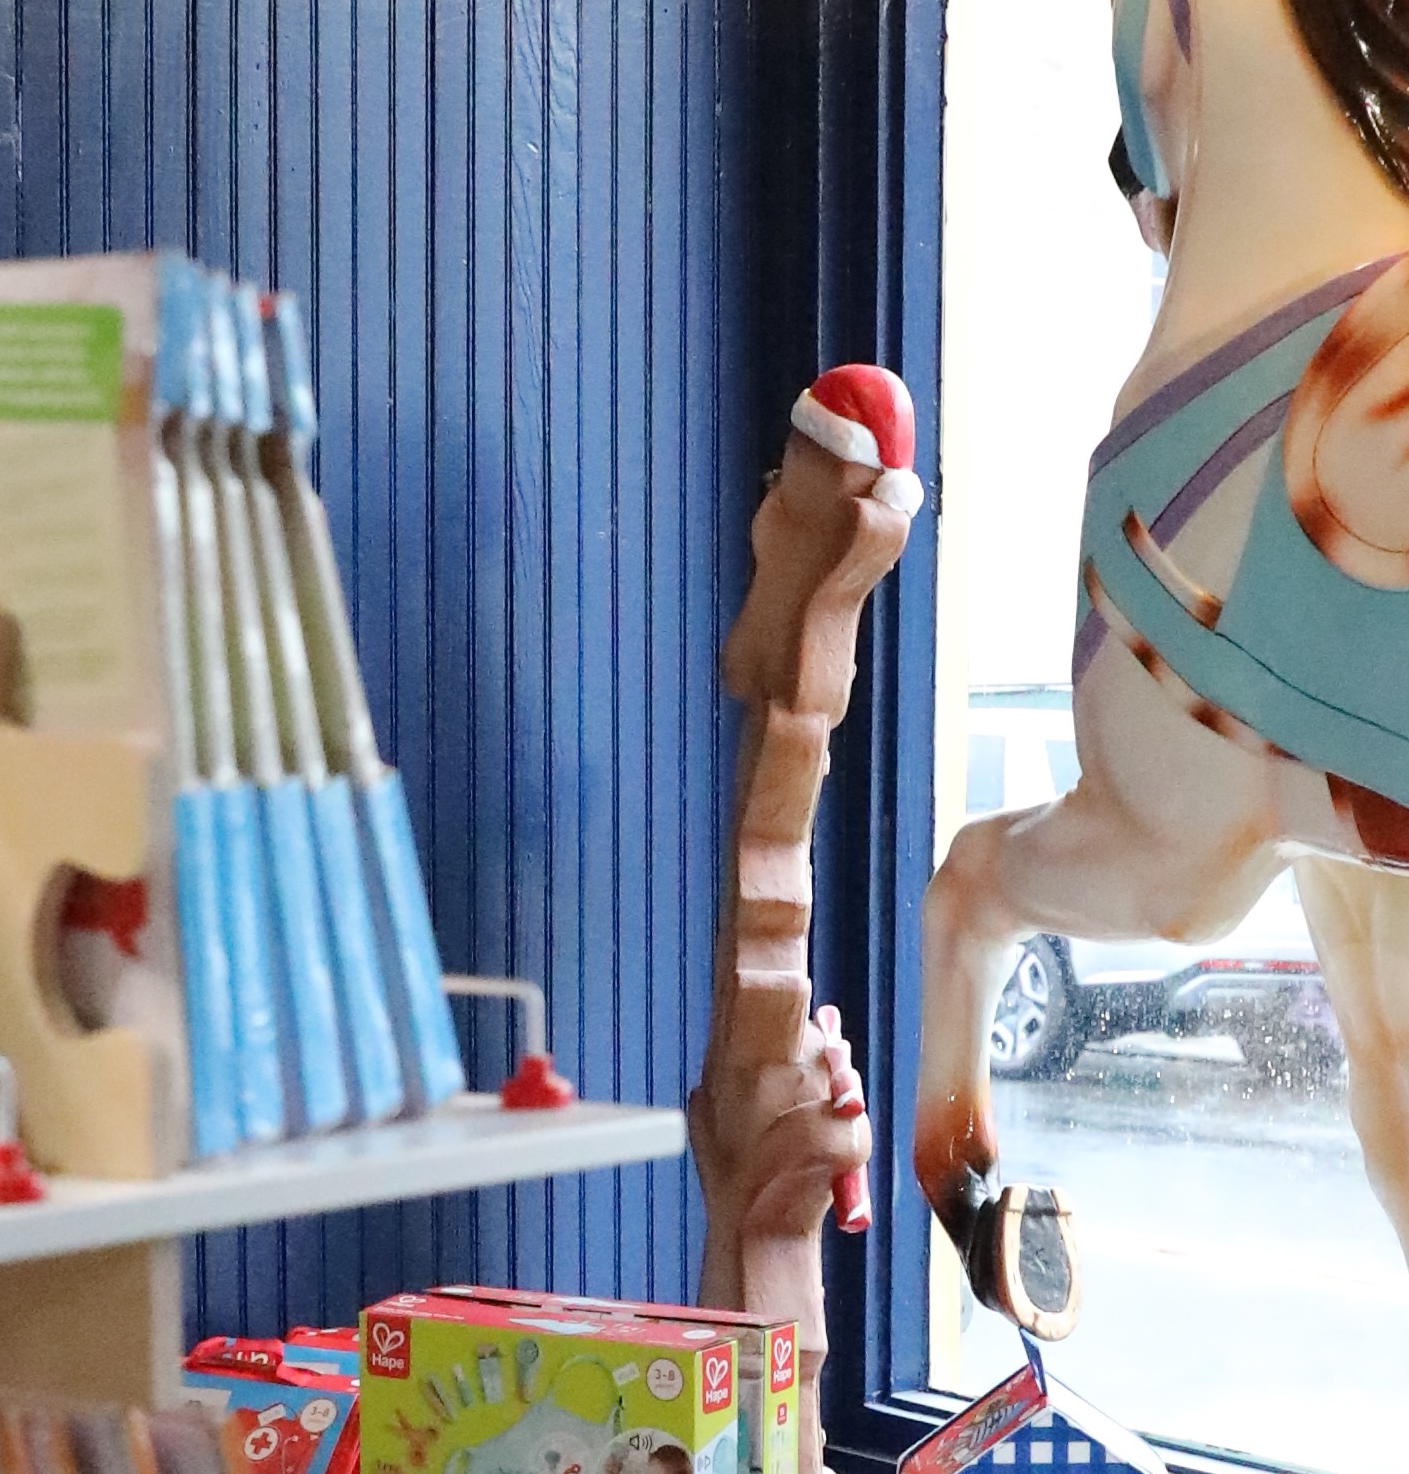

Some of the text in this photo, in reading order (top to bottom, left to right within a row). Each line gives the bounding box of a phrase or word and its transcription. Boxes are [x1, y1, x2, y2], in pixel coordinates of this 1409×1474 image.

[371, 1352, 406, 1370] Hape
[654, 1368, 676, 1382] 3-8
[773, 1367, 793, 1384] Hape
[705, 1388, 729, 1404] Hape
[309, 1405, 332, 1418] 3-8
